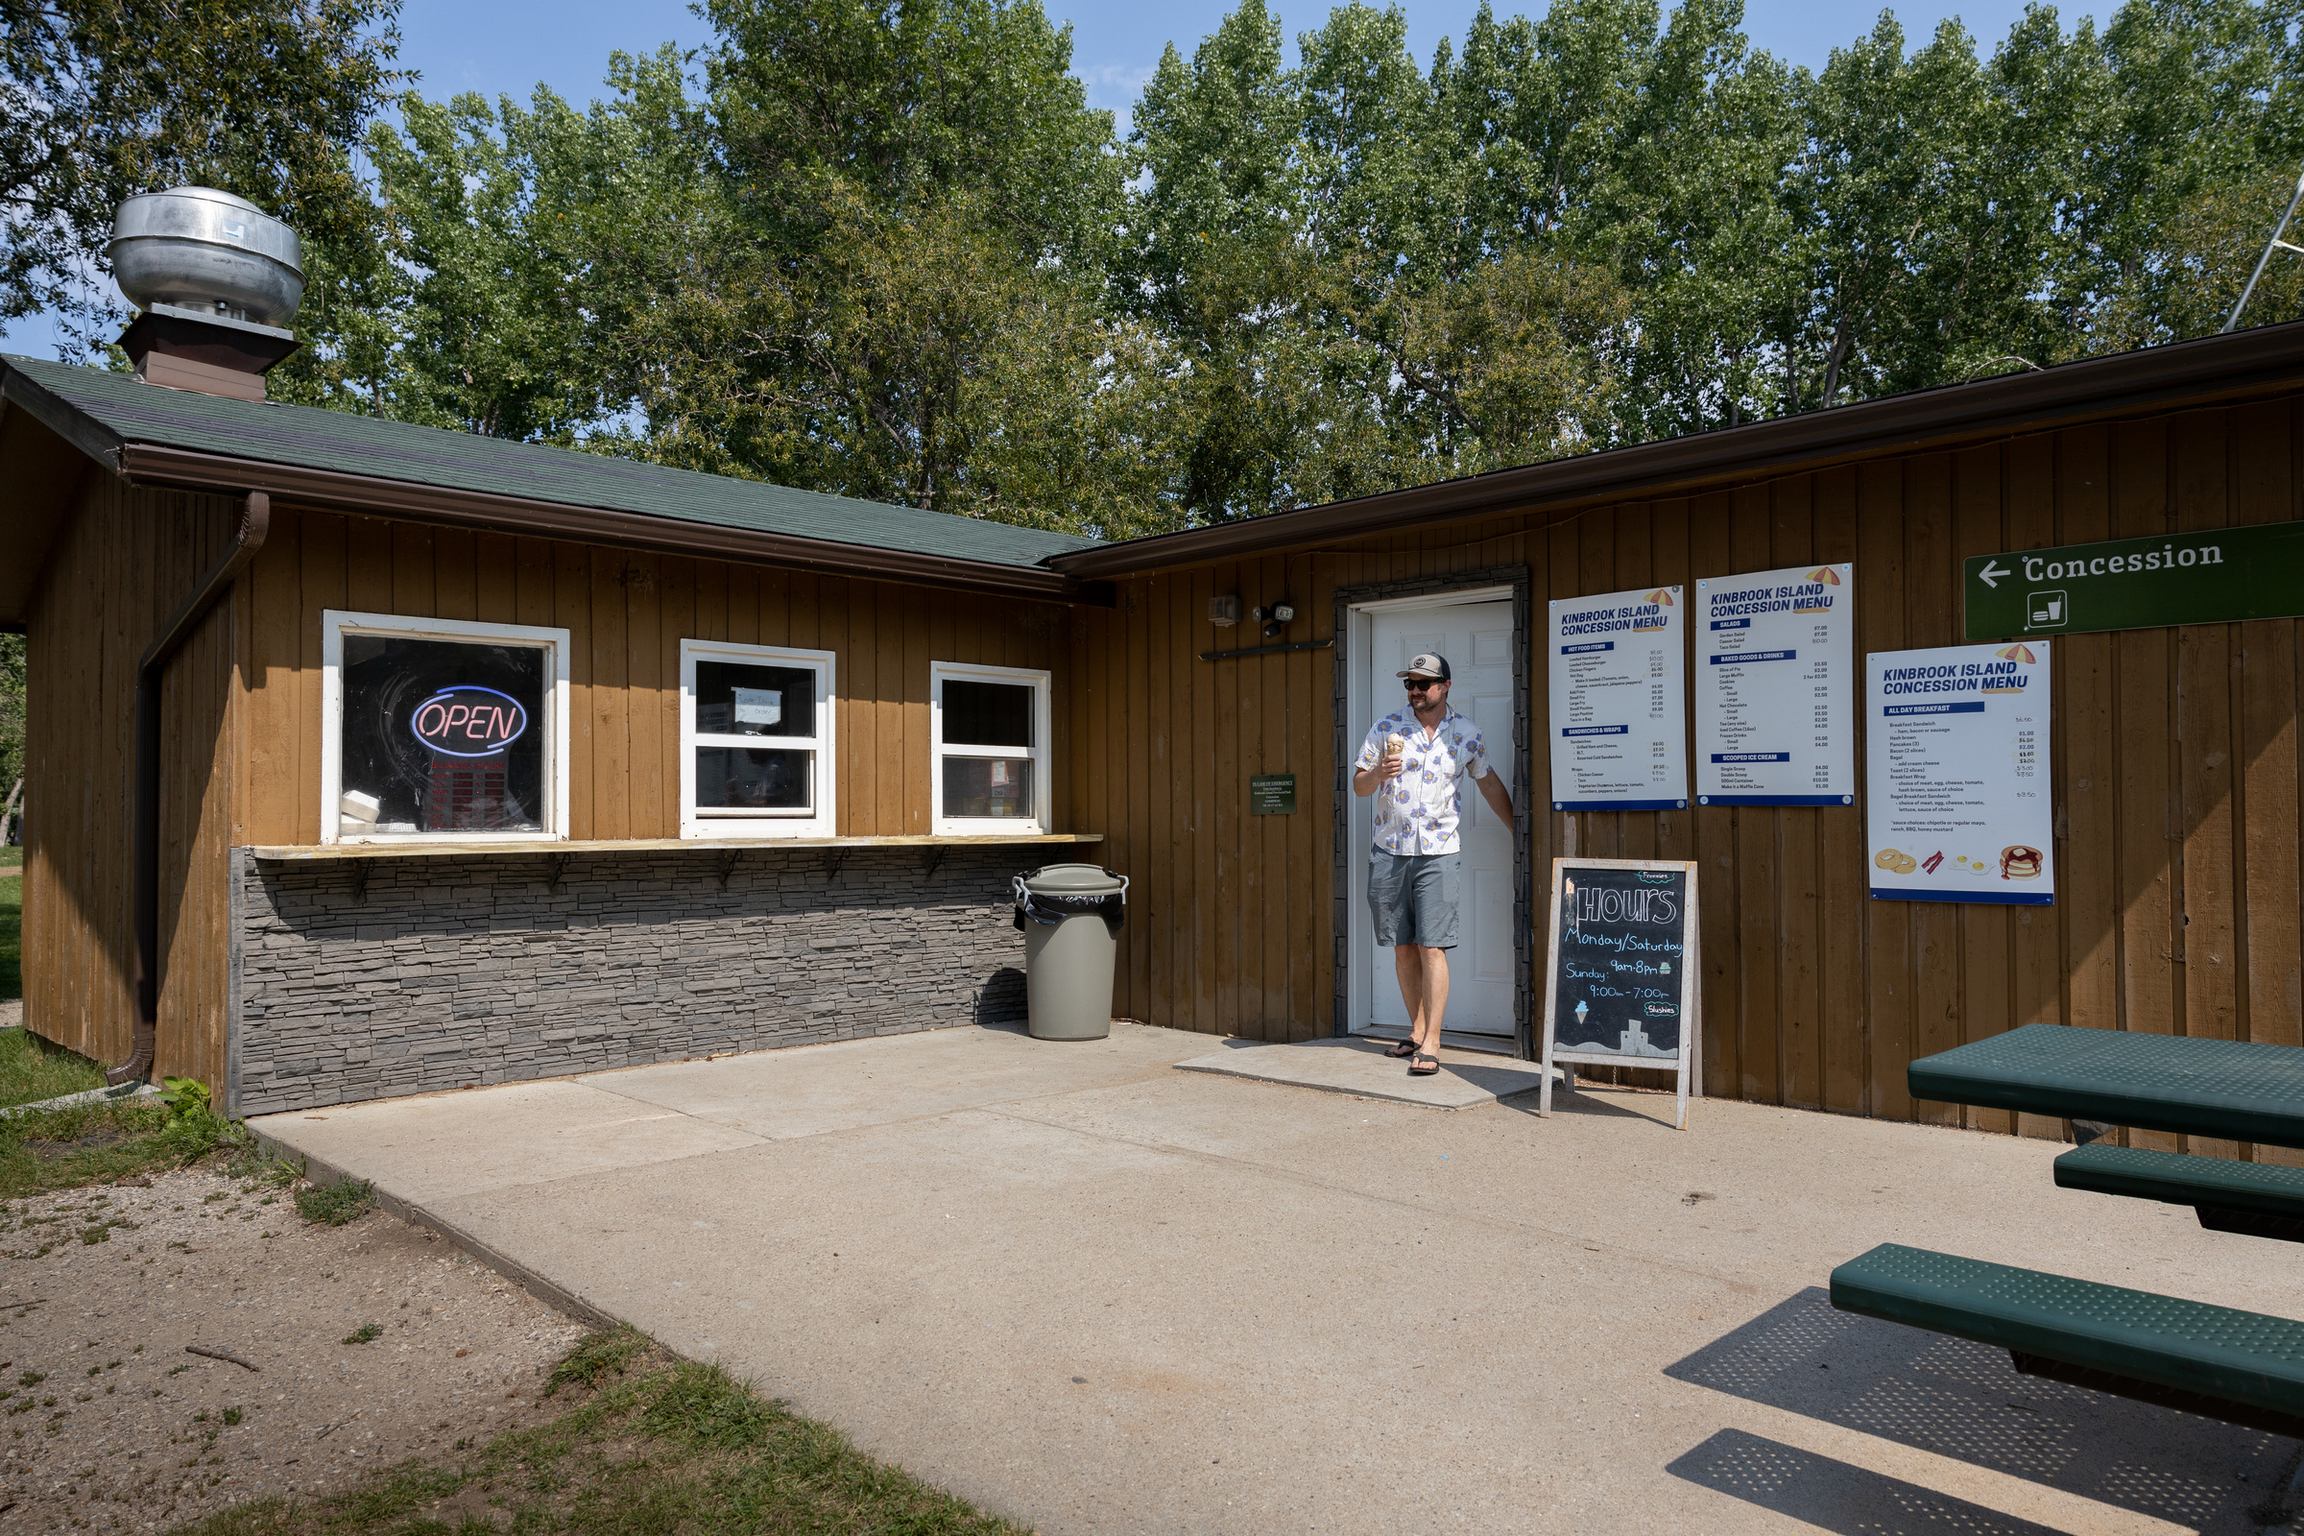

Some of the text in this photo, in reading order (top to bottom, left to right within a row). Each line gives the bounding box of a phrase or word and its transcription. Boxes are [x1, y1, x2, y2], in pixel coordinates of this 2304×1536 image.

[2025, 544, 2224, 582] Concession
[1711, 583, 1824, 605] KINBROOK ISLAND
[1562, 604, 1659, 624] KINBROOK ISLAND
[1711, 596, 1833, 617] CONCESSION MENU
[1562, 616, 1668, 636] CONCESSION MENU
[1719, 620, 1741, 628] SALADS
[1883, 661, 2017, 681] KINBROOK ISLAND
[1884, 675, 2028, 695] CONCESSION MENU
[1914, 704, 1950, 712] BREAKFAST
[418, 703, 517, 739] OPEN
[1566, 962, 1610, 982] Sunday:
